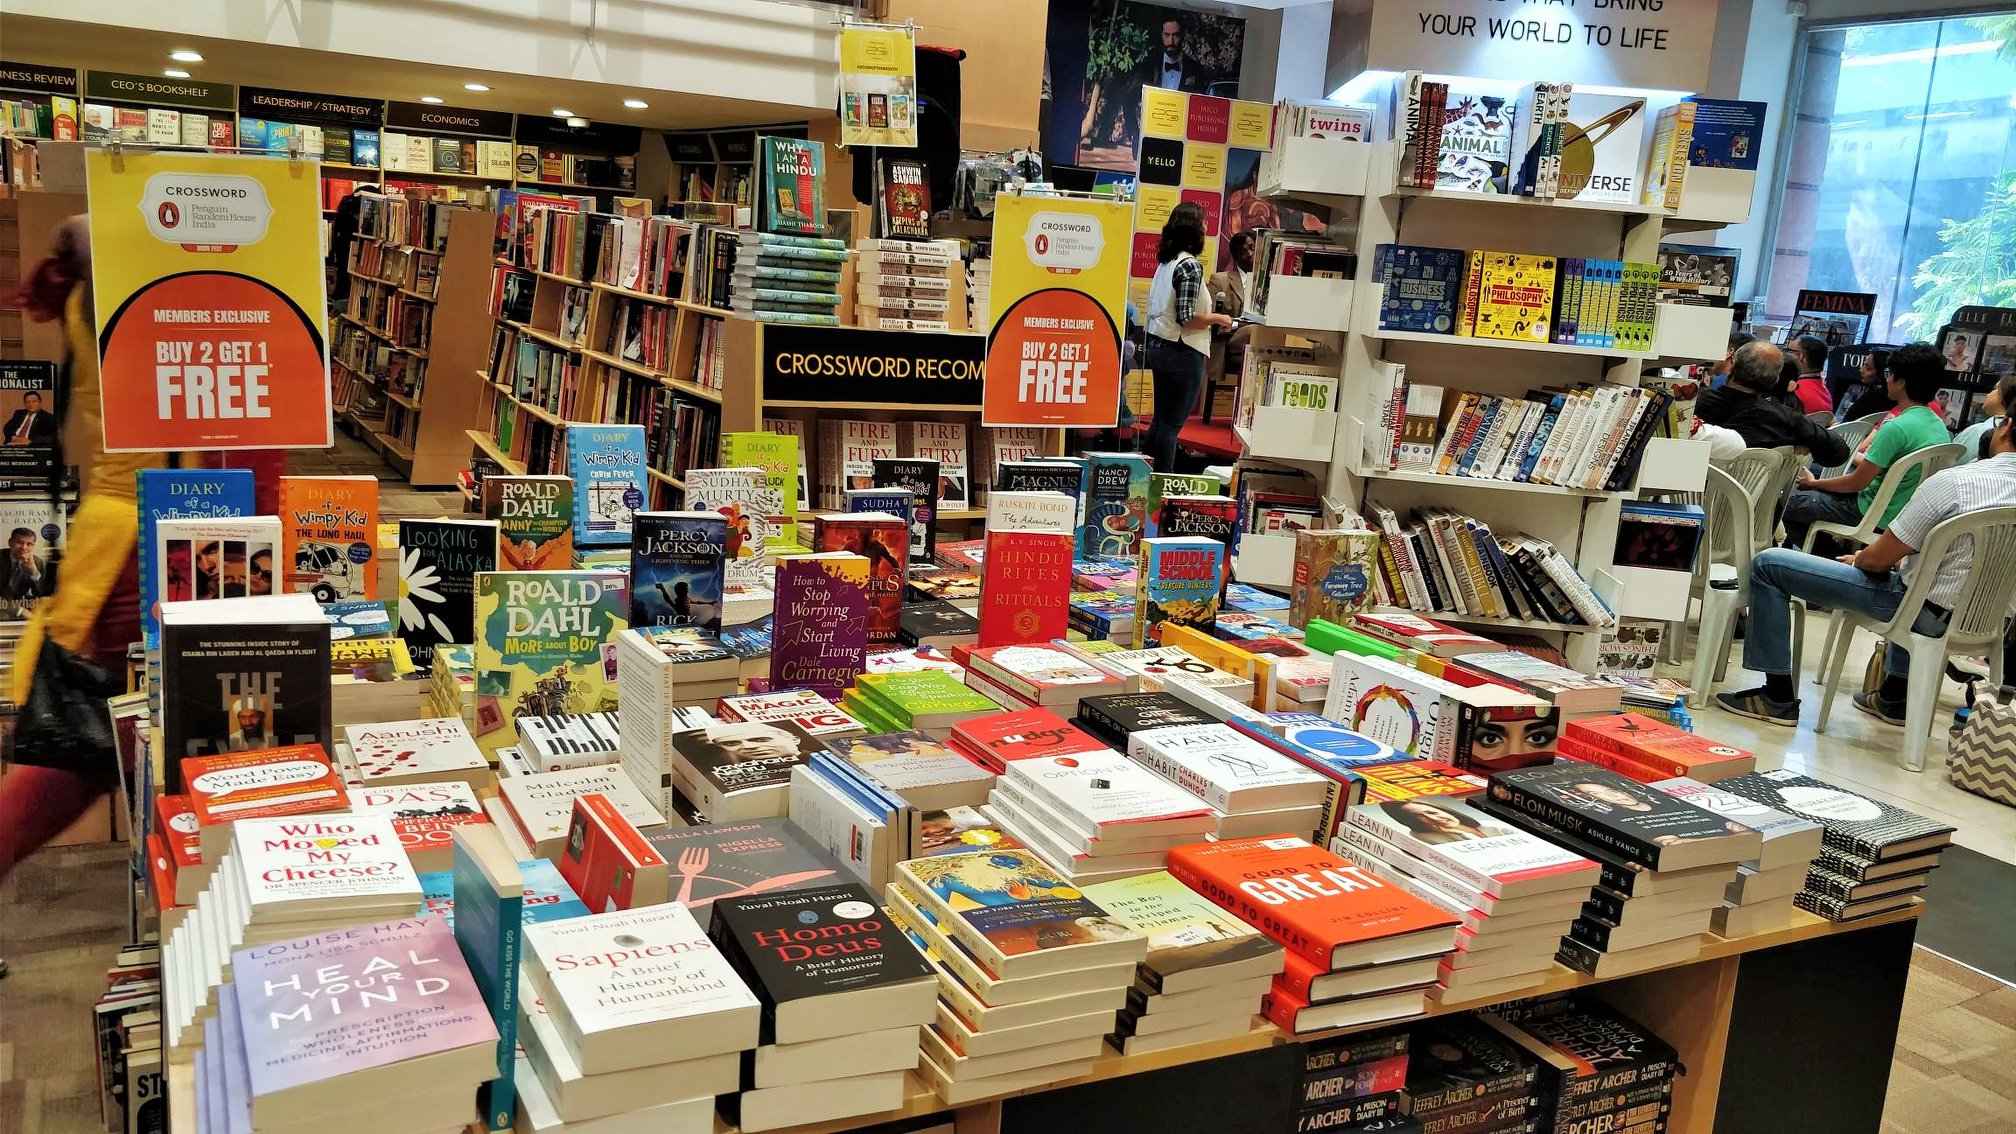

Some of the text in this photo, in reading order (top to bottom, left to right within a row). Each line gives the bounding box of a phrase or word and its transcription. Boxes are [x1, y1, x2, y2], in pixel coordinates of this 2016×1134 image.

[1419, 13, 1669, 50] YOUR WORLD TO LIFE
[34, 74, 75, 86] REVIEW
[111, 80, 208, 97] CEO'S BOOKSHELF
[253, 95, 312, 110] LEADERSHIP
[322, 103, 371, 116] STRATEGY
[1534, 92, 1545, 125] EARTH
[421, 113, 480, 127] ECONOMICS
[1190, 115, 1227, 125] PUBLISHING
[1309, 117, 1361, 133] twins
[776, 141, 803, 154] WHY
[1439, 136, 1499, 153] ANIMAL
[1148, 157, 1175, 168] YELLO
[1673, 128, 1692, 183] SKELETON
[776, 164, 817, 177] HINDU
[166, 186, 247, 199] CROSSWORD
[192, 204, 228, 214] Penguin
[192, 213, 256, 222] Random House
[192, 221, 216, 229] India
[1041, 222, 1091, 234] CROSSWORD
[1400, 284, 1445, 296] BUSINESS
[1491, 289, 1543, 303] PHILOSOPHY
[1802, 293, 1865, 312] FEMINA
[154, 309, 270, 324] MEMBERS EXCLUSIVE
[1024, 316, 1094, 331] MEMBERS EXCLUSIVE
[1958, 312, 1986, 323] ELLE
[156, 341, 267, 363] BUY 2 GET 1
[1022, 342, 1090, 361] BUY 2 GET 1
[776, 353, 986, 380] CROSSWORD RECOM
[1019, 360, 1088, 404] FREE
[1957, 373, 1981, 383] ELLE
[156, 365, 272, 420] FREE
[592, 433, 630, 443] DIARY
[849, 423, 890, 440] FIRE
[919, 423, 961, 440] FIRE
[747, 443, 781, 453] DIARY
[590, 470, 635, 479] CABIN FEVER
[894, 466, 924, 475] DIARY
[1098, 468, 1129, 477] NANCY
[701, 477, 750, 487] SUDHA
[1011, 475, 1078, 488] MAGNUS
[1098, 475, 1128, 485] DREW
[1162, 478, 1208, 495] ROALD
[170, 482, 224, 495] DIARY
[308, 488, 352, 501] DIARY
[502, 483, 560, 500] ROALD
[698, 489, 755, 501] MURTY
[502, 499, 560, 518] DAHL
[863, 500, 900, 509] SUDHA
[998, 500, 1068, 512] RUSKIN BOND
[295, 510, 368, 529] Wimpy Kid
[1191, 513, 1225, 524] PERCY
[1168, 519, 1232, 534] JACKSON
[296, 529, 365, 541] THE LONG HAUL
[406, 525, 478, 549] LOOKING
[660, 530, 710, 543] PERCY
[639, 537, 724, 556] JACKSON
[1029, 539, 1056, 547] SINGH
[437, 551, 493, 572] ALASKA
[1000, 551, 1065, 565] HINDU
[1160, 551, 1215, 566] MIDDLE
[727, 570, 758, 578] DRUM
[1003, 569, 1059, 581] RITES
[1158, 565, 1215, 581] SCHOOL
[794, 576, 826, 586] How to
[507, 579, 601, 606] ROALD
[803, 587, 831, 603] Stop
[340, 603, 378, 611] SNOW
[995, 594, 1062, 608] RITUALS
[791, 602, 849, 621] Worrying
[506, 606, 600, 638] DAHL
[821, 618, 837, 628] and
[802, 628, 834, 643] Start
[505, 636, 597, 655] MORE ABOUT BOY
[820, 643, 861, 662] Living
[800, 657, 821, 667] Dale
[782, 660, 861, 687] Carnegie
[740, 698, 820, 711] MAGIC
[758, 708, 835, 721] THINKING
[1138, 709, 1181, 718] GIRL
[360, 725, 459, 741] Aarushi
[988, 727, 1074, 748] nudge
[1157, 734, 1241, 749] HABIT
[1044, 767, 1111, 780] OPTION
[525, 776, 610, 791] Malcolm
[366, 790, 451, 806] DAS
[530, 783, 617, 800] Gladwell
[279, 823, 355, 836] Who
[704, 824, 762, 837] LAWSON
[718, 837, 777, 849] NIGELLA
[723, 841, 783, 854] EXPRESS
[308, 851, 352, 866] My
[262, 862, 398, 883] Cheese?
[1242, 861, 1333, 880] GOOD TO
[1239, 867, 1384, 905] GREAT
[738, 901, 773, 912] Yuval
[775, 897, 810, 907] Noah
[813, 892, 853, 903] Harari
[1202, 879, 1308, 951] GOOD TO GREAT
[1356, 906, 1407, 919] COLLINS
[551, 925, 588, 936] Yuval
[593, 920, 630, 930] Noah
[633, 912, 676, 924] Harari
[250, 918, 429, 960] LOUISE HAY
[752, 919, 883, 947] Homo
[555, 938, 711, 972] Sapiens
[774, 936, 883, 963] Deus
[806, 952, 884, 970] Brief History
[806, 960, 883, 977] of Tomorrow
[264, 949, 441, 997] HEAL
[303, 971, 404, 1000] YOUR
[599, 969, 707, 994] History of
[597, 979, 727, 1008] Humankind
[270, 977, 450, 1030] MIND
[315, 1004, 445, 1039] PRESCRIPTION
[302, 1018, 415, 1051] WHOLENESS
[345, 1032, 428, 1057] INTUITION
